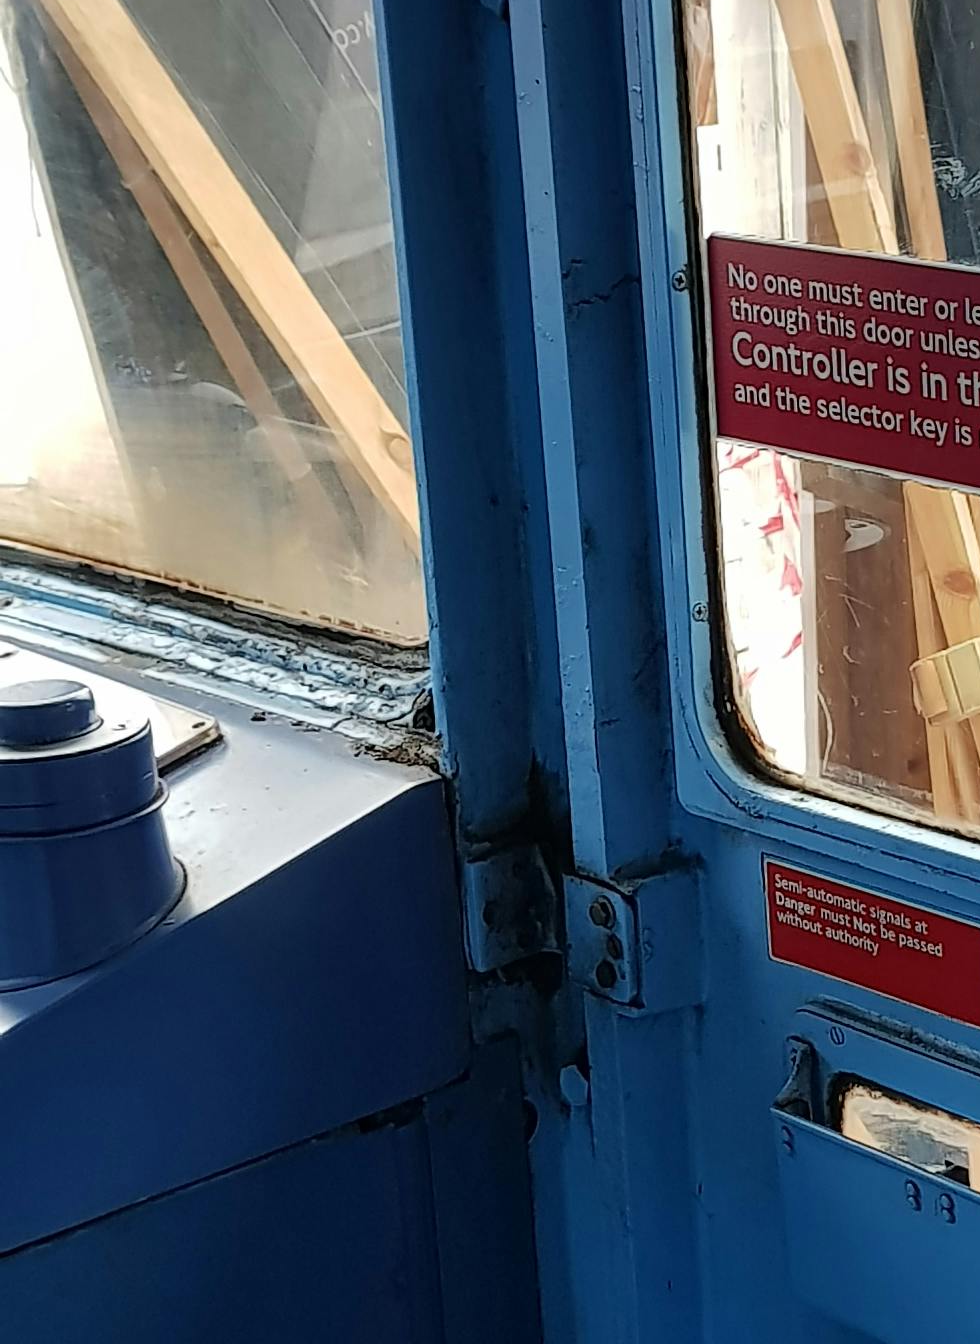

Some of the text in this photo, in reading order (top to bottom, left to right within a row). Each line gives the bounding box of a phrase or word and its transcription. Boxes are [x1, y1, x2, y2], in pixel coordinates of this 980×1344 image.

[727, 262, 758, 291] No
[763, 274, 803, 298] one
[808, 280, 863, 307] must
[869, 289, 928, 317] enter
[934, 298, 959, 321] or
[730, 297, 811, 336] through
[815, 309, 857, 339] this
[862, 317, 914, 348] door
[732, 331, 878, 388] Controller
[886, 356, 911, 394] is
[920, 361, 948, 401] in
[734, 382, 771, 407] and
[775, 386, 811, 415] the
[816, 397, 904, 432] selector
[910, 409, 949, 447] key
[954, 417, 973, 446] is
[774, 874, 928, 935] Semi-automatic signals at
[775, 891, 943, 958] Danger must Not be passed
[777, 910, 879, 956] without authority
